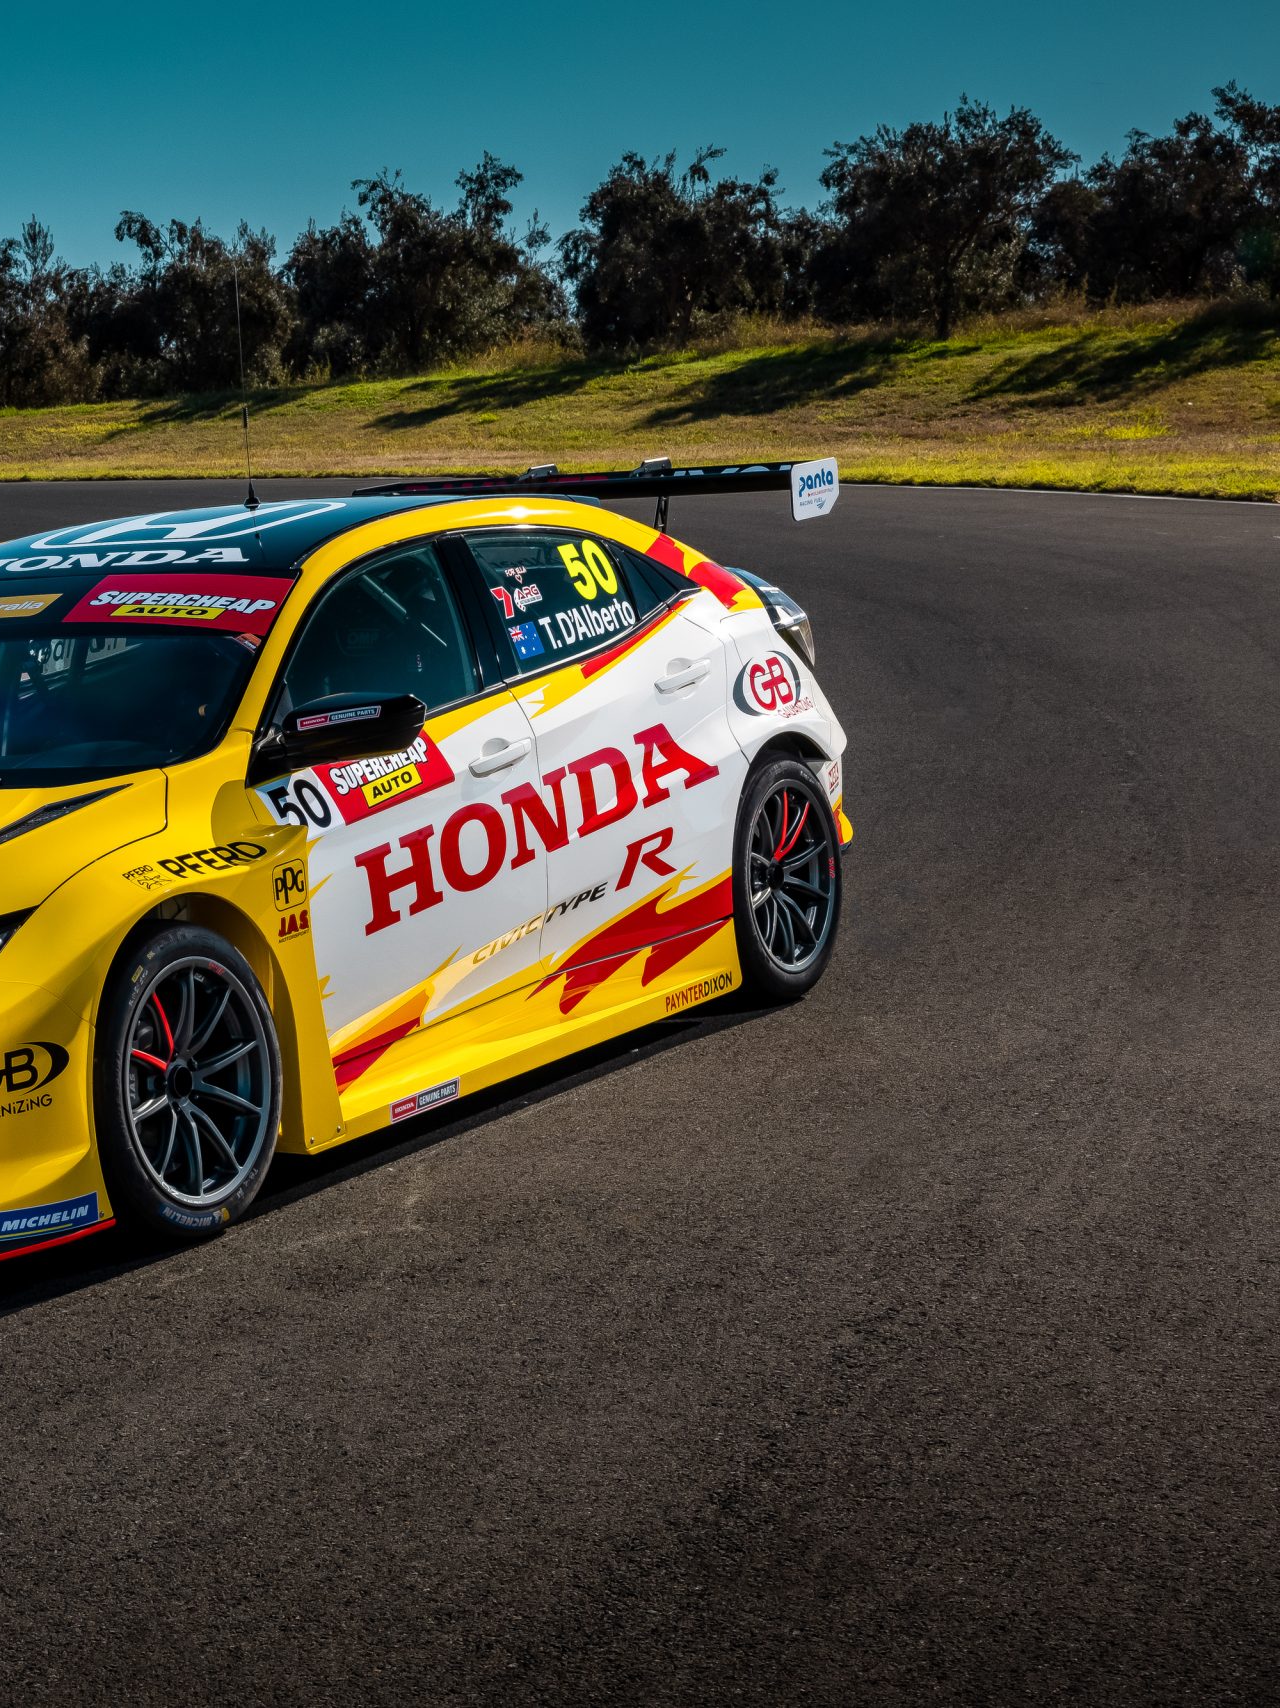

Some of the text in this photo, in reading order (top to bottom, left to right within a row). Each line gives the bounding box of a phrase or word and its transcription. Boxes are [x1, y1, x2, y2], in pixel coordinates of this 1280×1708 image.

[799, 468, 834, 497] panta
[557, 539, 617, 600] 50
[89, 590, 276, 614] SUPERCHEAP
[518, 584, 540, 600] ARG
[125, 607, 209, 616] AUTO
[538, 598, 635, 649] T. D'Alberto
[749, 656, 794, 711] GB
[302, 708, 375, 726] HONDA GENUINE PARTS
[329, 736, 428, 796] SUPERCHEAP
[373, 771, 413, 799] AUTO
[267, 779, 331, 828] 50
[354, 722, 720, 936] HONDA
[122, 865, 154, 880] PFERD
[156, 841, 267, 879] PFERD
[274, 866, 304, 904] PPG
[472, 827, 677, 965] CIVIC TYPE R
[278, 910, 309, 937] JAS
[278, 928, 310, 944] MOTORSPORT
[665, 971, 733, 1012] PAYNTERDIXON
[395, 1084, 456, 1114] HONDA GENUINE PARTS
[1, 1205, 89, 1232] MICHELIN
[162, 1206, 213, 1227] MICHELIN
